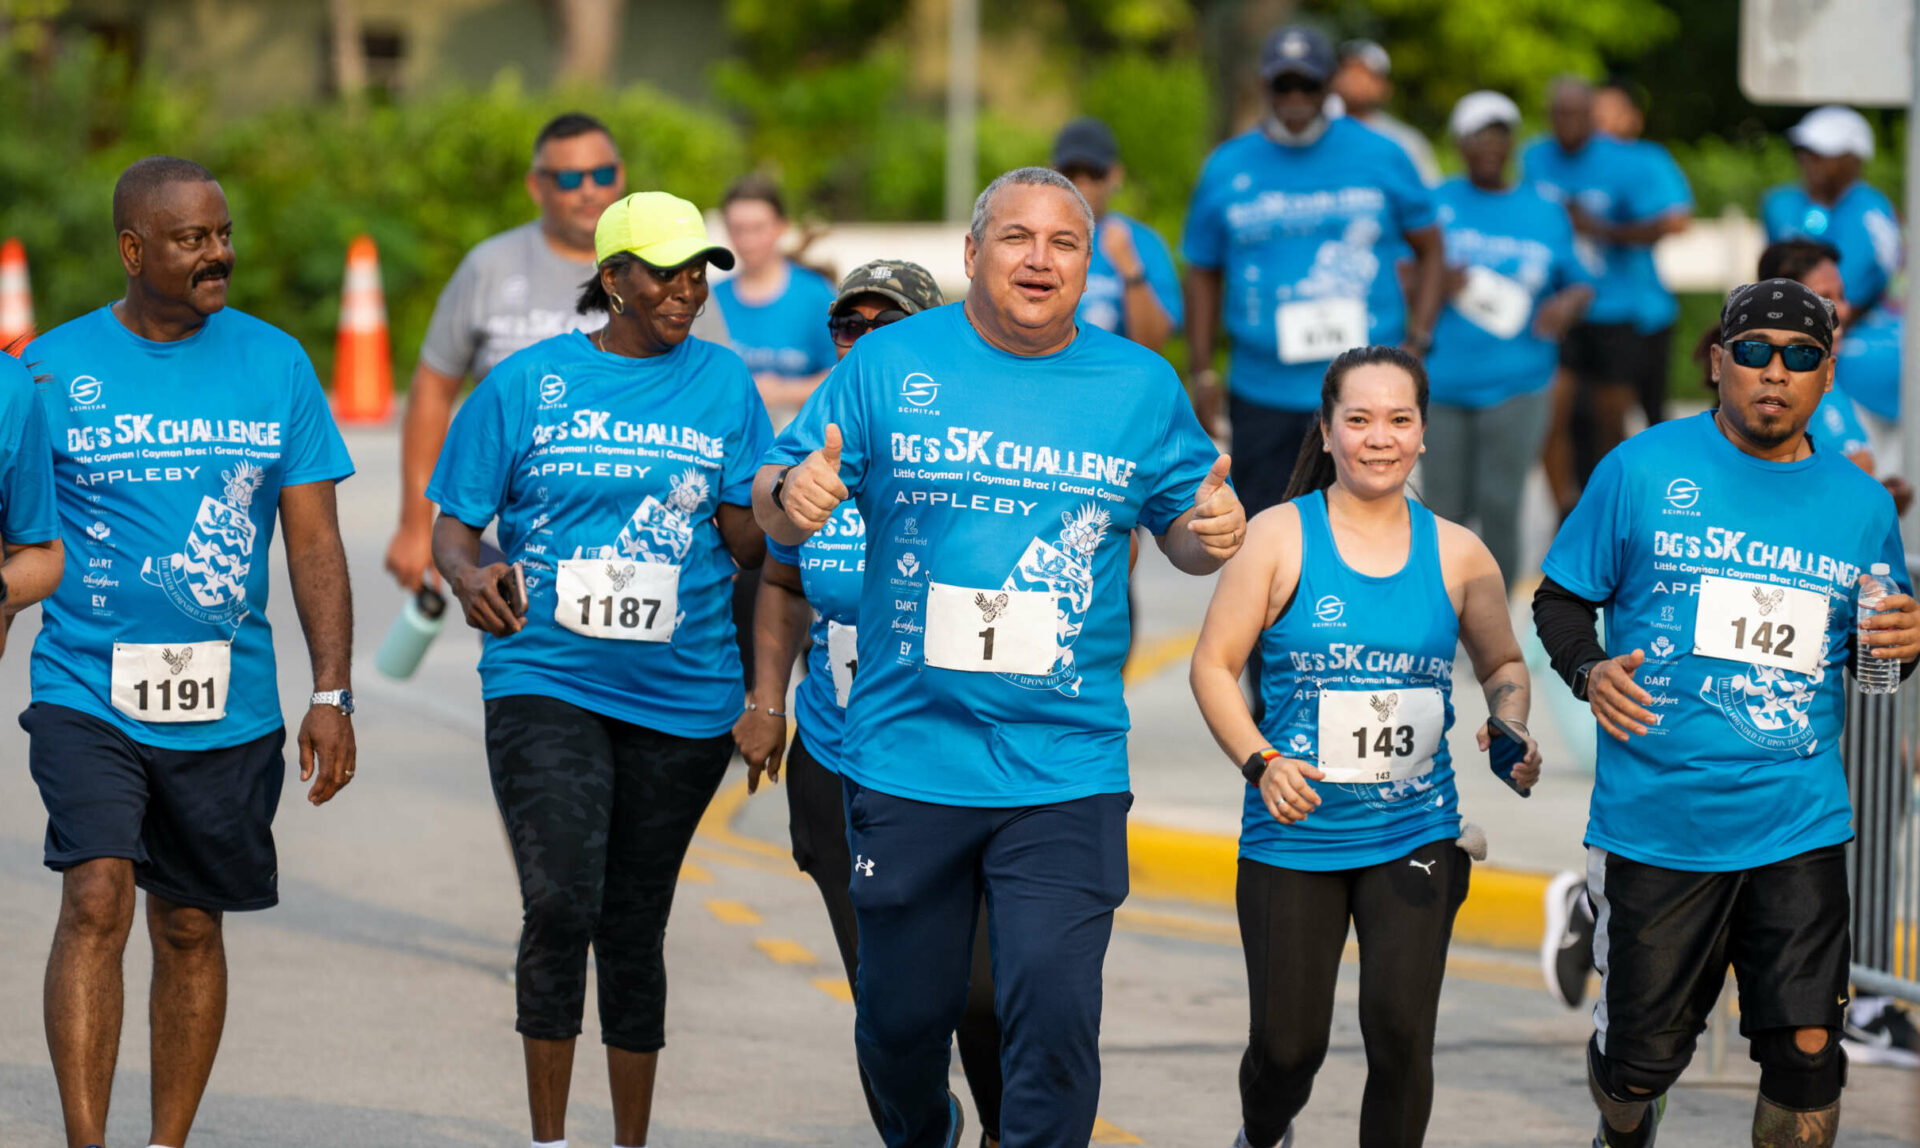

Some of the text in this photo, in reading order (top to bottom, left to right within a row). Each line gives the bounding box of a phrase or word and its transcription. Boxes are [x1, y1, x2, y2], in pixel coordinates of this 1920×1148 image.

[898, 406, 941, 416] SCIMITAR
[114, 413, 156, 444] 5K
[157, 418, 281, 447] CHALLENGE
[571, 409, 611, 441] 5K
[613, 421, 724, 459] CHALLENGE
[94, 451, 135, 463] Cayman
[142, 449, 182, 460] Cayman
[184, 447, 207, 456] Brac
[214, 446, 243, 456] Grand
[245, 449, 281, 460] Cayman
[549, 445, 587, 455] Cayman
[594, 445, 635, 456] Cayman
[637, 448, 660, 457] Brac
[666, 450, 693, 462] Grand
[944, 426, 994, 466] 5K
[996, 441, 1137, 488] CHALLENGE
[75, 466, 201, 486] APPLEBY
[528, 462, 652, 479] APPLEBY
[893, 467, 915, 479] Little
[917, 469, 963, 481] Cayman
[973, 471, 1020, 488] Cayman
[1023, 477, 1050, 491] Brac
[1059, 482, 1095, 497] Grand
[1097, 488, 1126, 504] Cayman
[894, 490, 1039, 516] APPLEBY
[1662, 509, 1701, 517] SCIMITAR
[817, 541, 852, 551] Cayman
[1704, 526, 1746, 563] 5K
[89, 557, 113, 569] DART
[1654, 561, 1677, 572] Little
[1679, 563, 1719, 575] Cayman
[1726, 567, 1767, 581] Cayman
[1769, 573, 1791, 585] Brac
[1798, 579, 1828, 594] Grand
[92, 594, 107, 608] EY
[895, 599, 918, 612] DART
[577, 595, 661, 630] 1187
[978, 627, 995, 661] 1
[1731, 617, 1796, 658] 142
[900, 641, 912, 656] EY
[1328, 643, 1366, 672] 5K
[1366, 651, 1453, 680] CHALLEN
[1349, 675, 1385, 684] Cayman
[1644, 675, 1671, 687] DART
[134, 677, 216, 711] 1191
[1352, 725, 1415, 759] 143
[1375, 771, 1390, 781] 143
